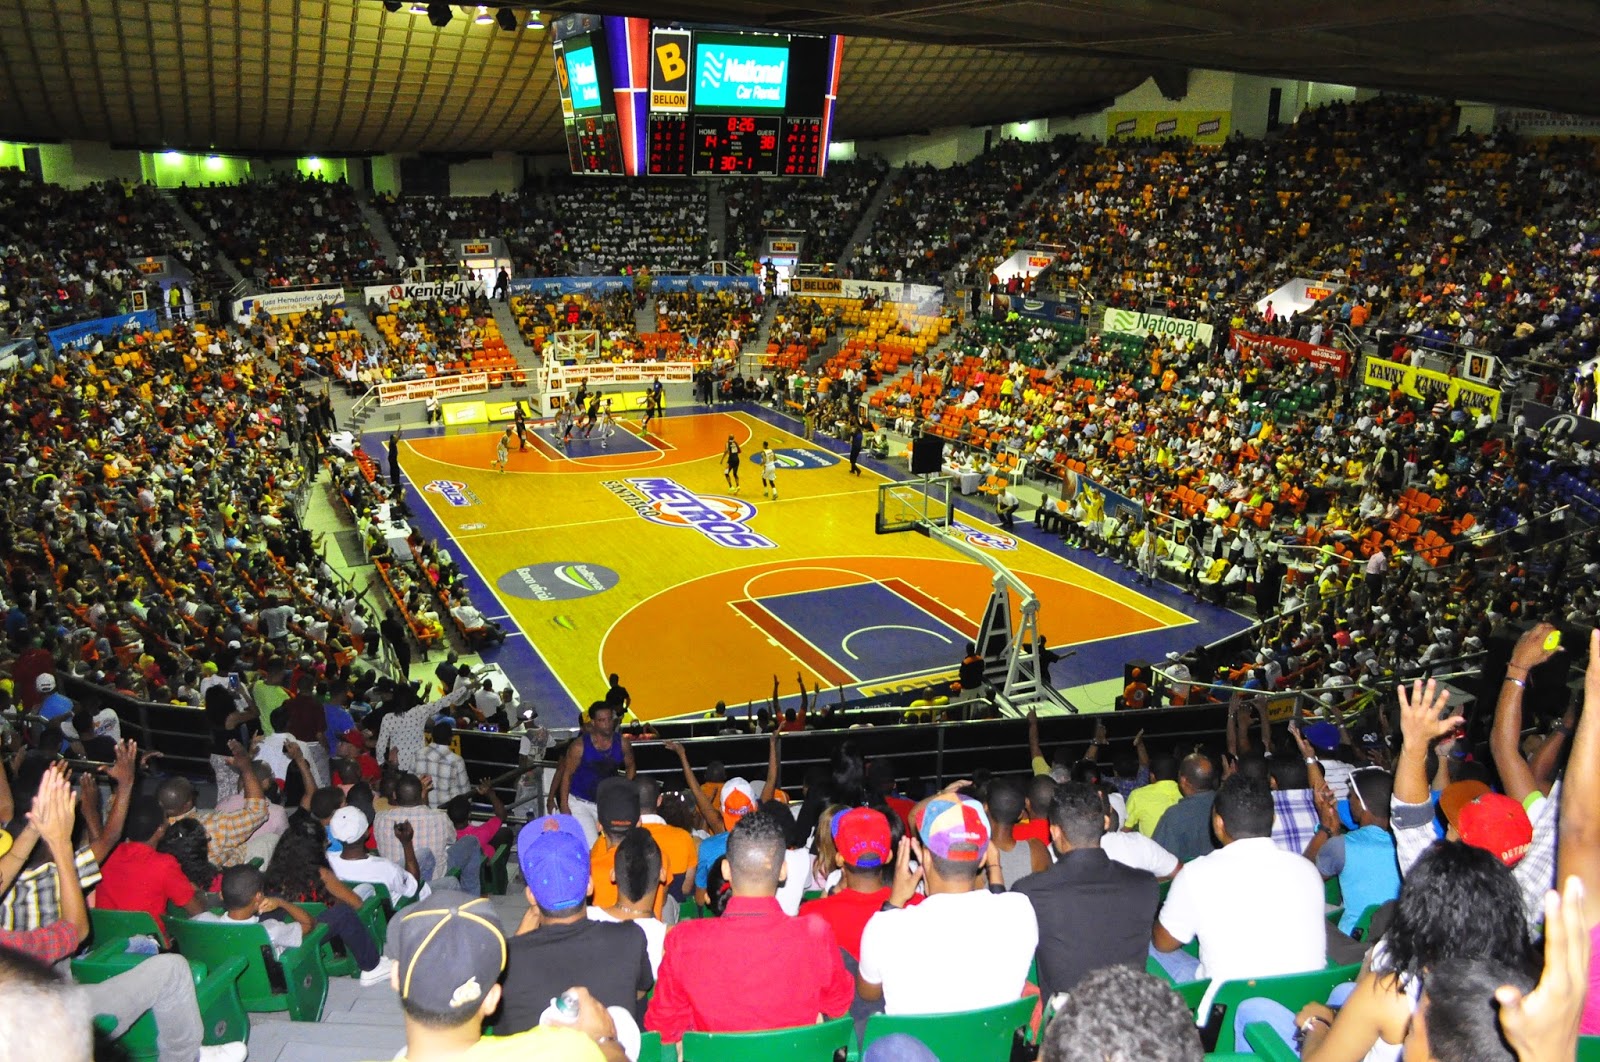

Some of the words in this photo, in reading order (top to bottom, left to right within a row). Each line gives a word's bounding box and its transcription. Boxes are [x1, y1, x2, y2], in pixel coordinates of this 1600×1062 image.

[656, 43, 686, 82] B
[724, 58, 784, 84] National
[654, 95, 685, 104] BELLON
[736, 85, 752, 99] Car
[728, 117, 755, 132] 8:26
[706, 135, 717, 148] 14
[760, 136, 775, 149] 38
[405, 283, 464, 298] Kendall
[804, 282, 840, 291] BELLON
[278, 295, 314, 303] Hernández
[1136, 313, 1199, 337] National
[1370, 364, 1406, 383] KANNY
[551, 398, 559, 407] B
[602, 480, 661, 517] SANTIAGO
[628, 478, 776, 548] METROS
[516, 568, 536, 584] Banco
[529, 583, 556, 601] oficial
